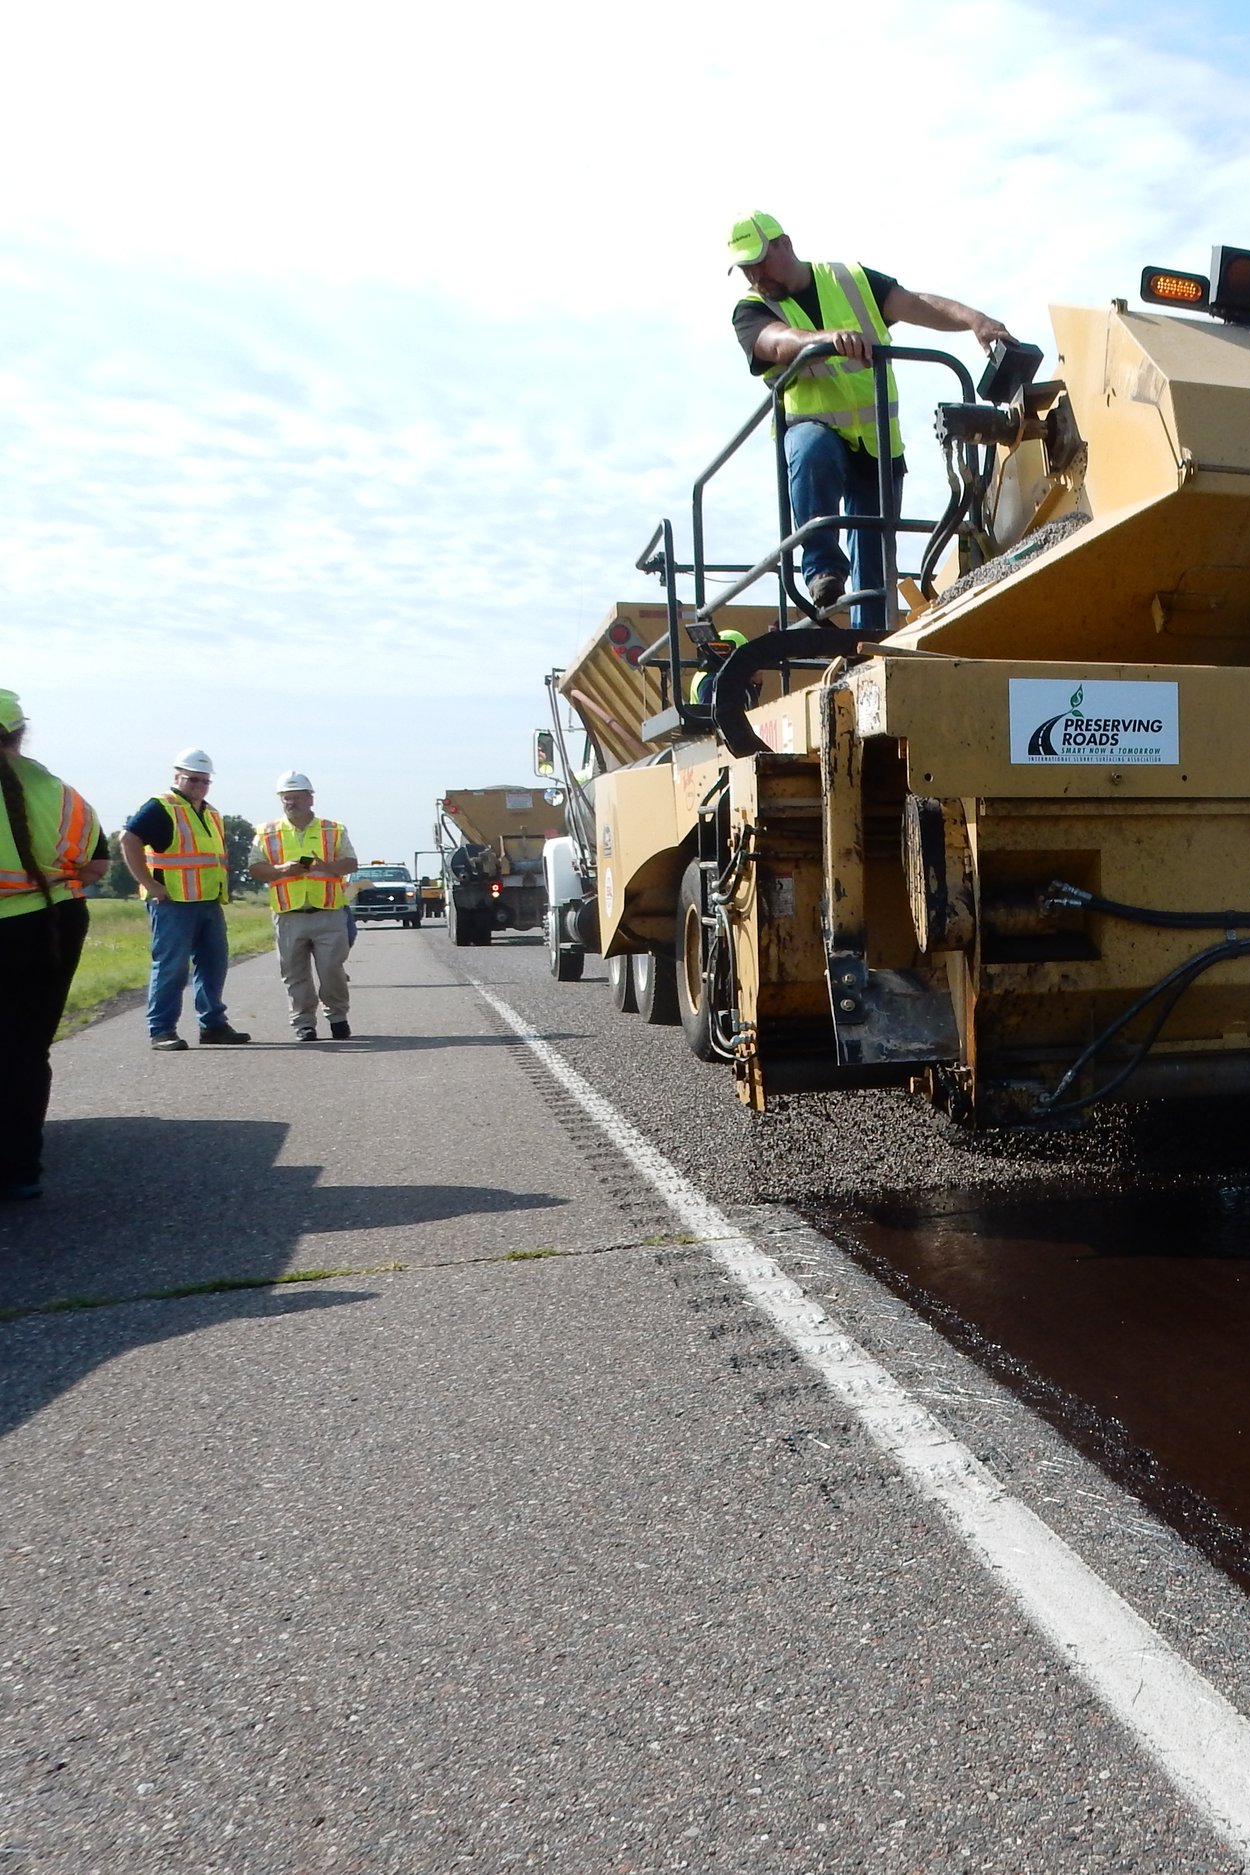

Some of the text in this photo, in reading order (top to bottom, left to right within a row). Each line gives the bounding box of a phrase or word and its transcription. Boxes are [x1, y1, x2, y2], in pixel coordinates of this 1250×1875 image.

[1064, 718, 1163, 733] PRESERVING
[1062, 732, 1119, 746] ROADS
[1118, 747, 1161, 755] TOMORROW
